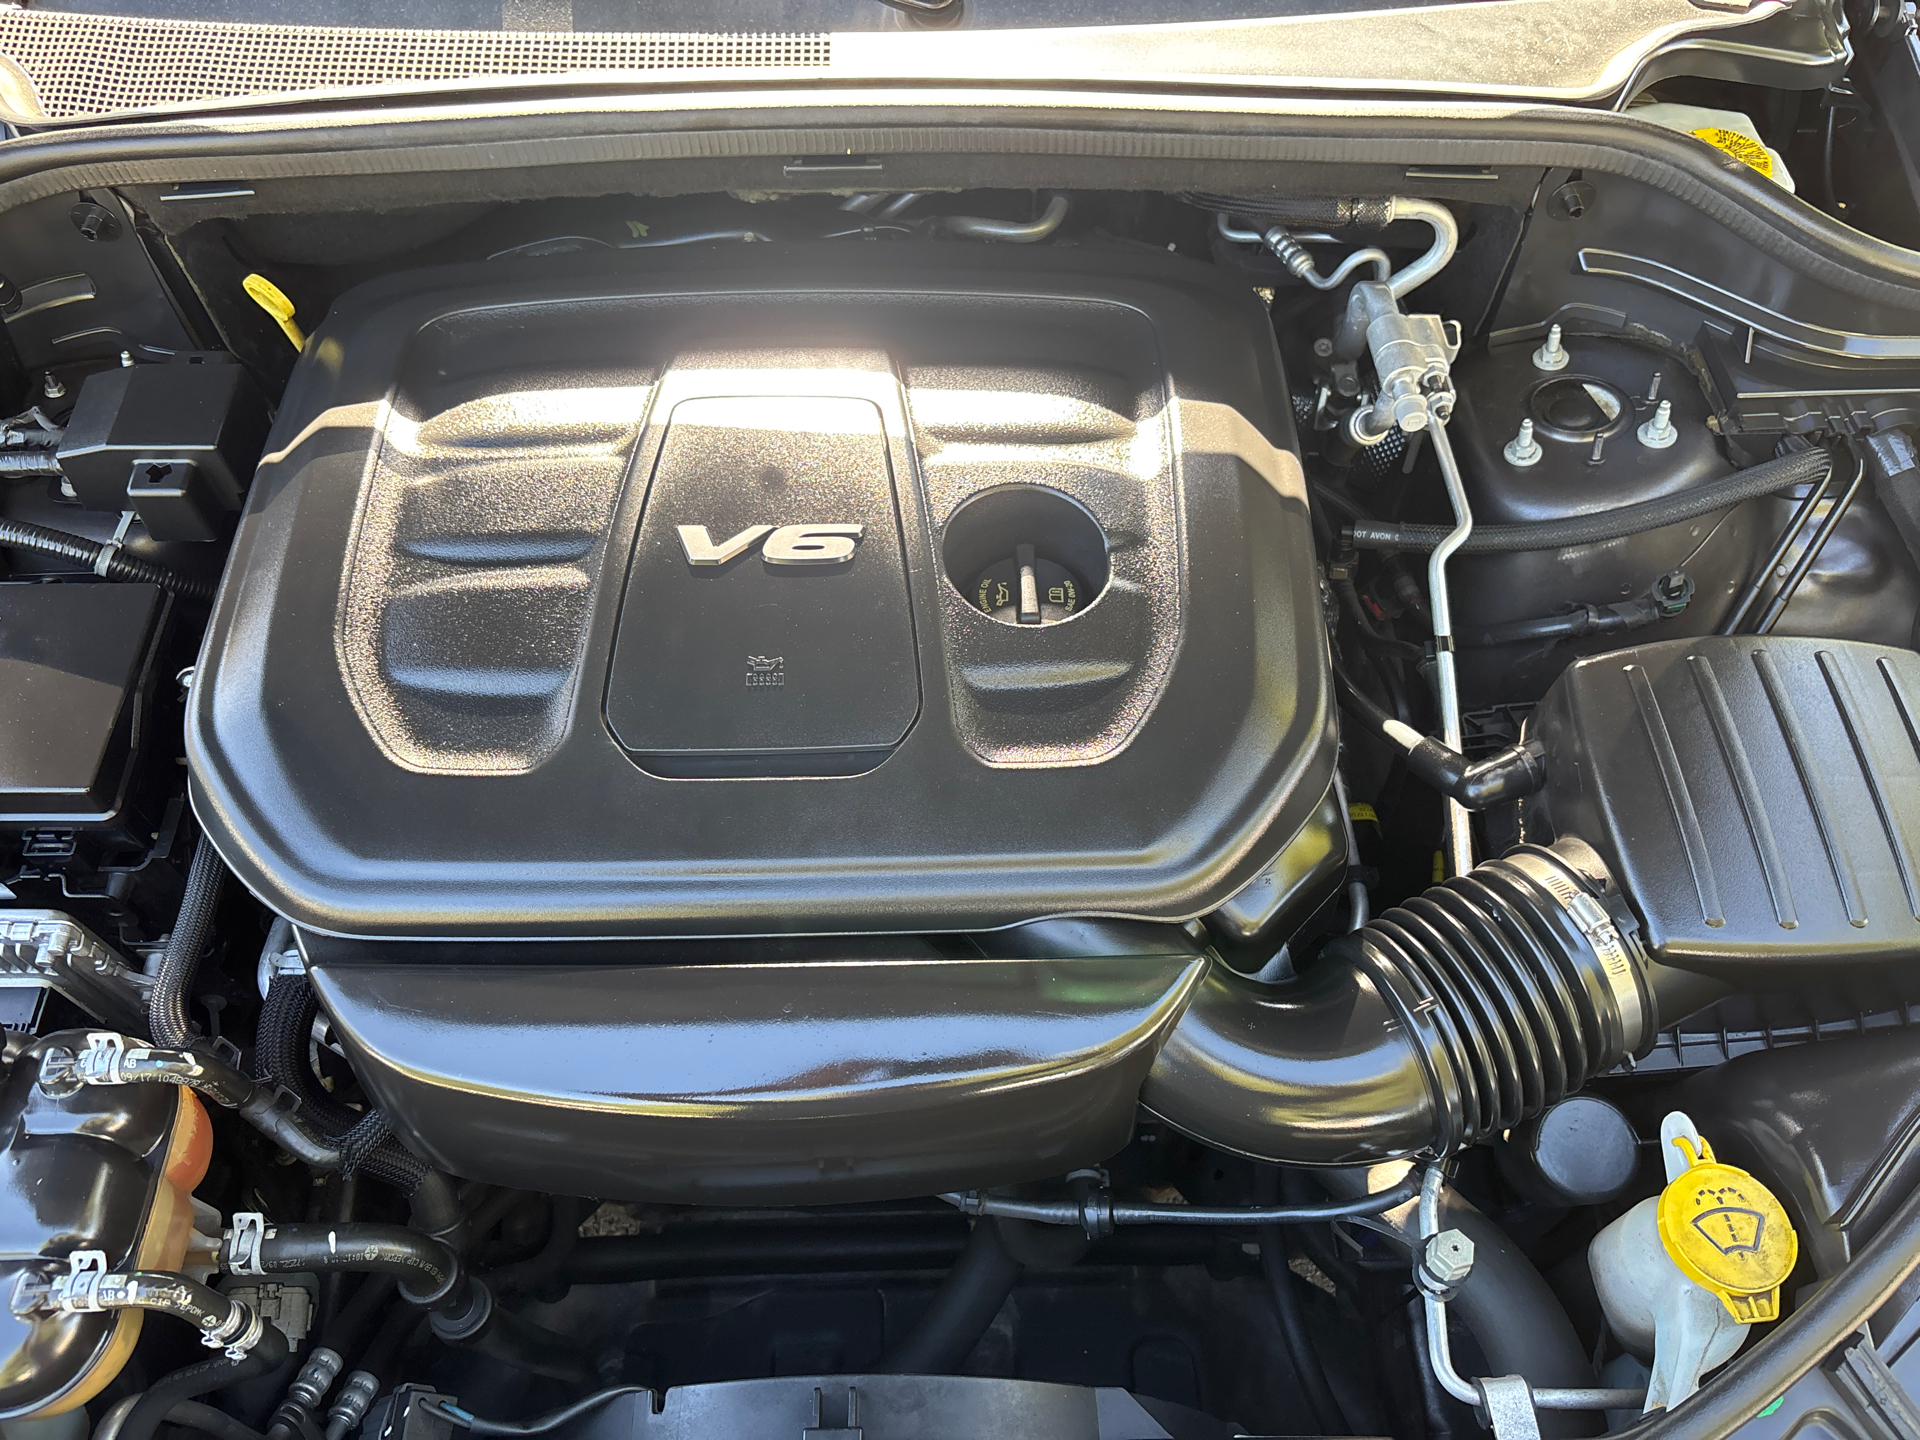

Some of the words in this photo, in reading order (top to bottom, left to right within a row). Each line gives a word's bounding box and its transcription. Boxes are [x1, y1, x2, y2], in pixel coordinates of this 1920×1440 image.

[1370, 532, 1391, 540] AVON
[676, 524, 865, 566] V6
[981, 578, 992, 588] OIL
[1064, 580, 1076, 598] 0W-20
[979, 589, 992, 613] ENGINE
[1064, 599, 1076, 612] SAE
[123, 1059, 137, 1069] AB
